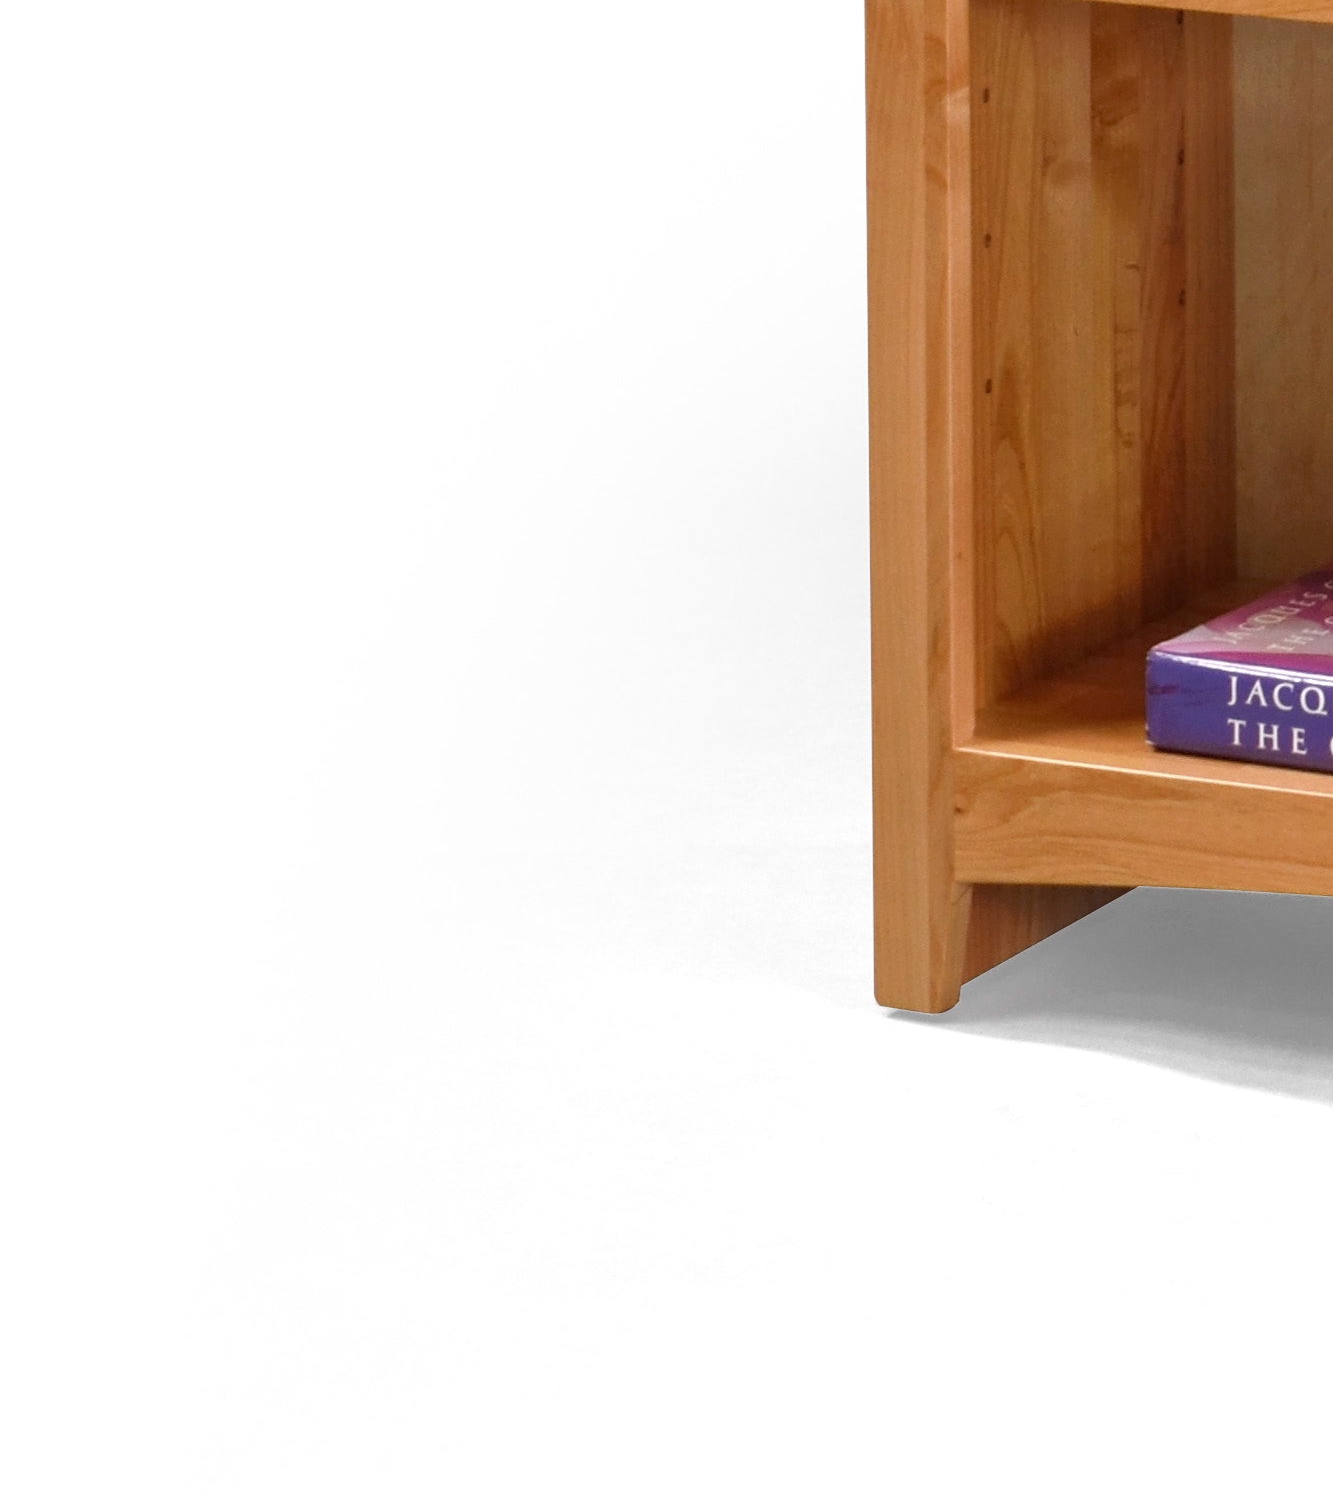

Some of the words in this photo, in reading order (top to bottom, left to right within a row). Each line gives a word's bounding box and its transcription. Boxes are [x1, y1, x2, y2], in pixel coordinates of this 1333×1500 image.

[1211, 590, 1328, 646] JACQUES
[1266, 626, 1330, 653] THE
[1227, 718, 1309, 756] THE
